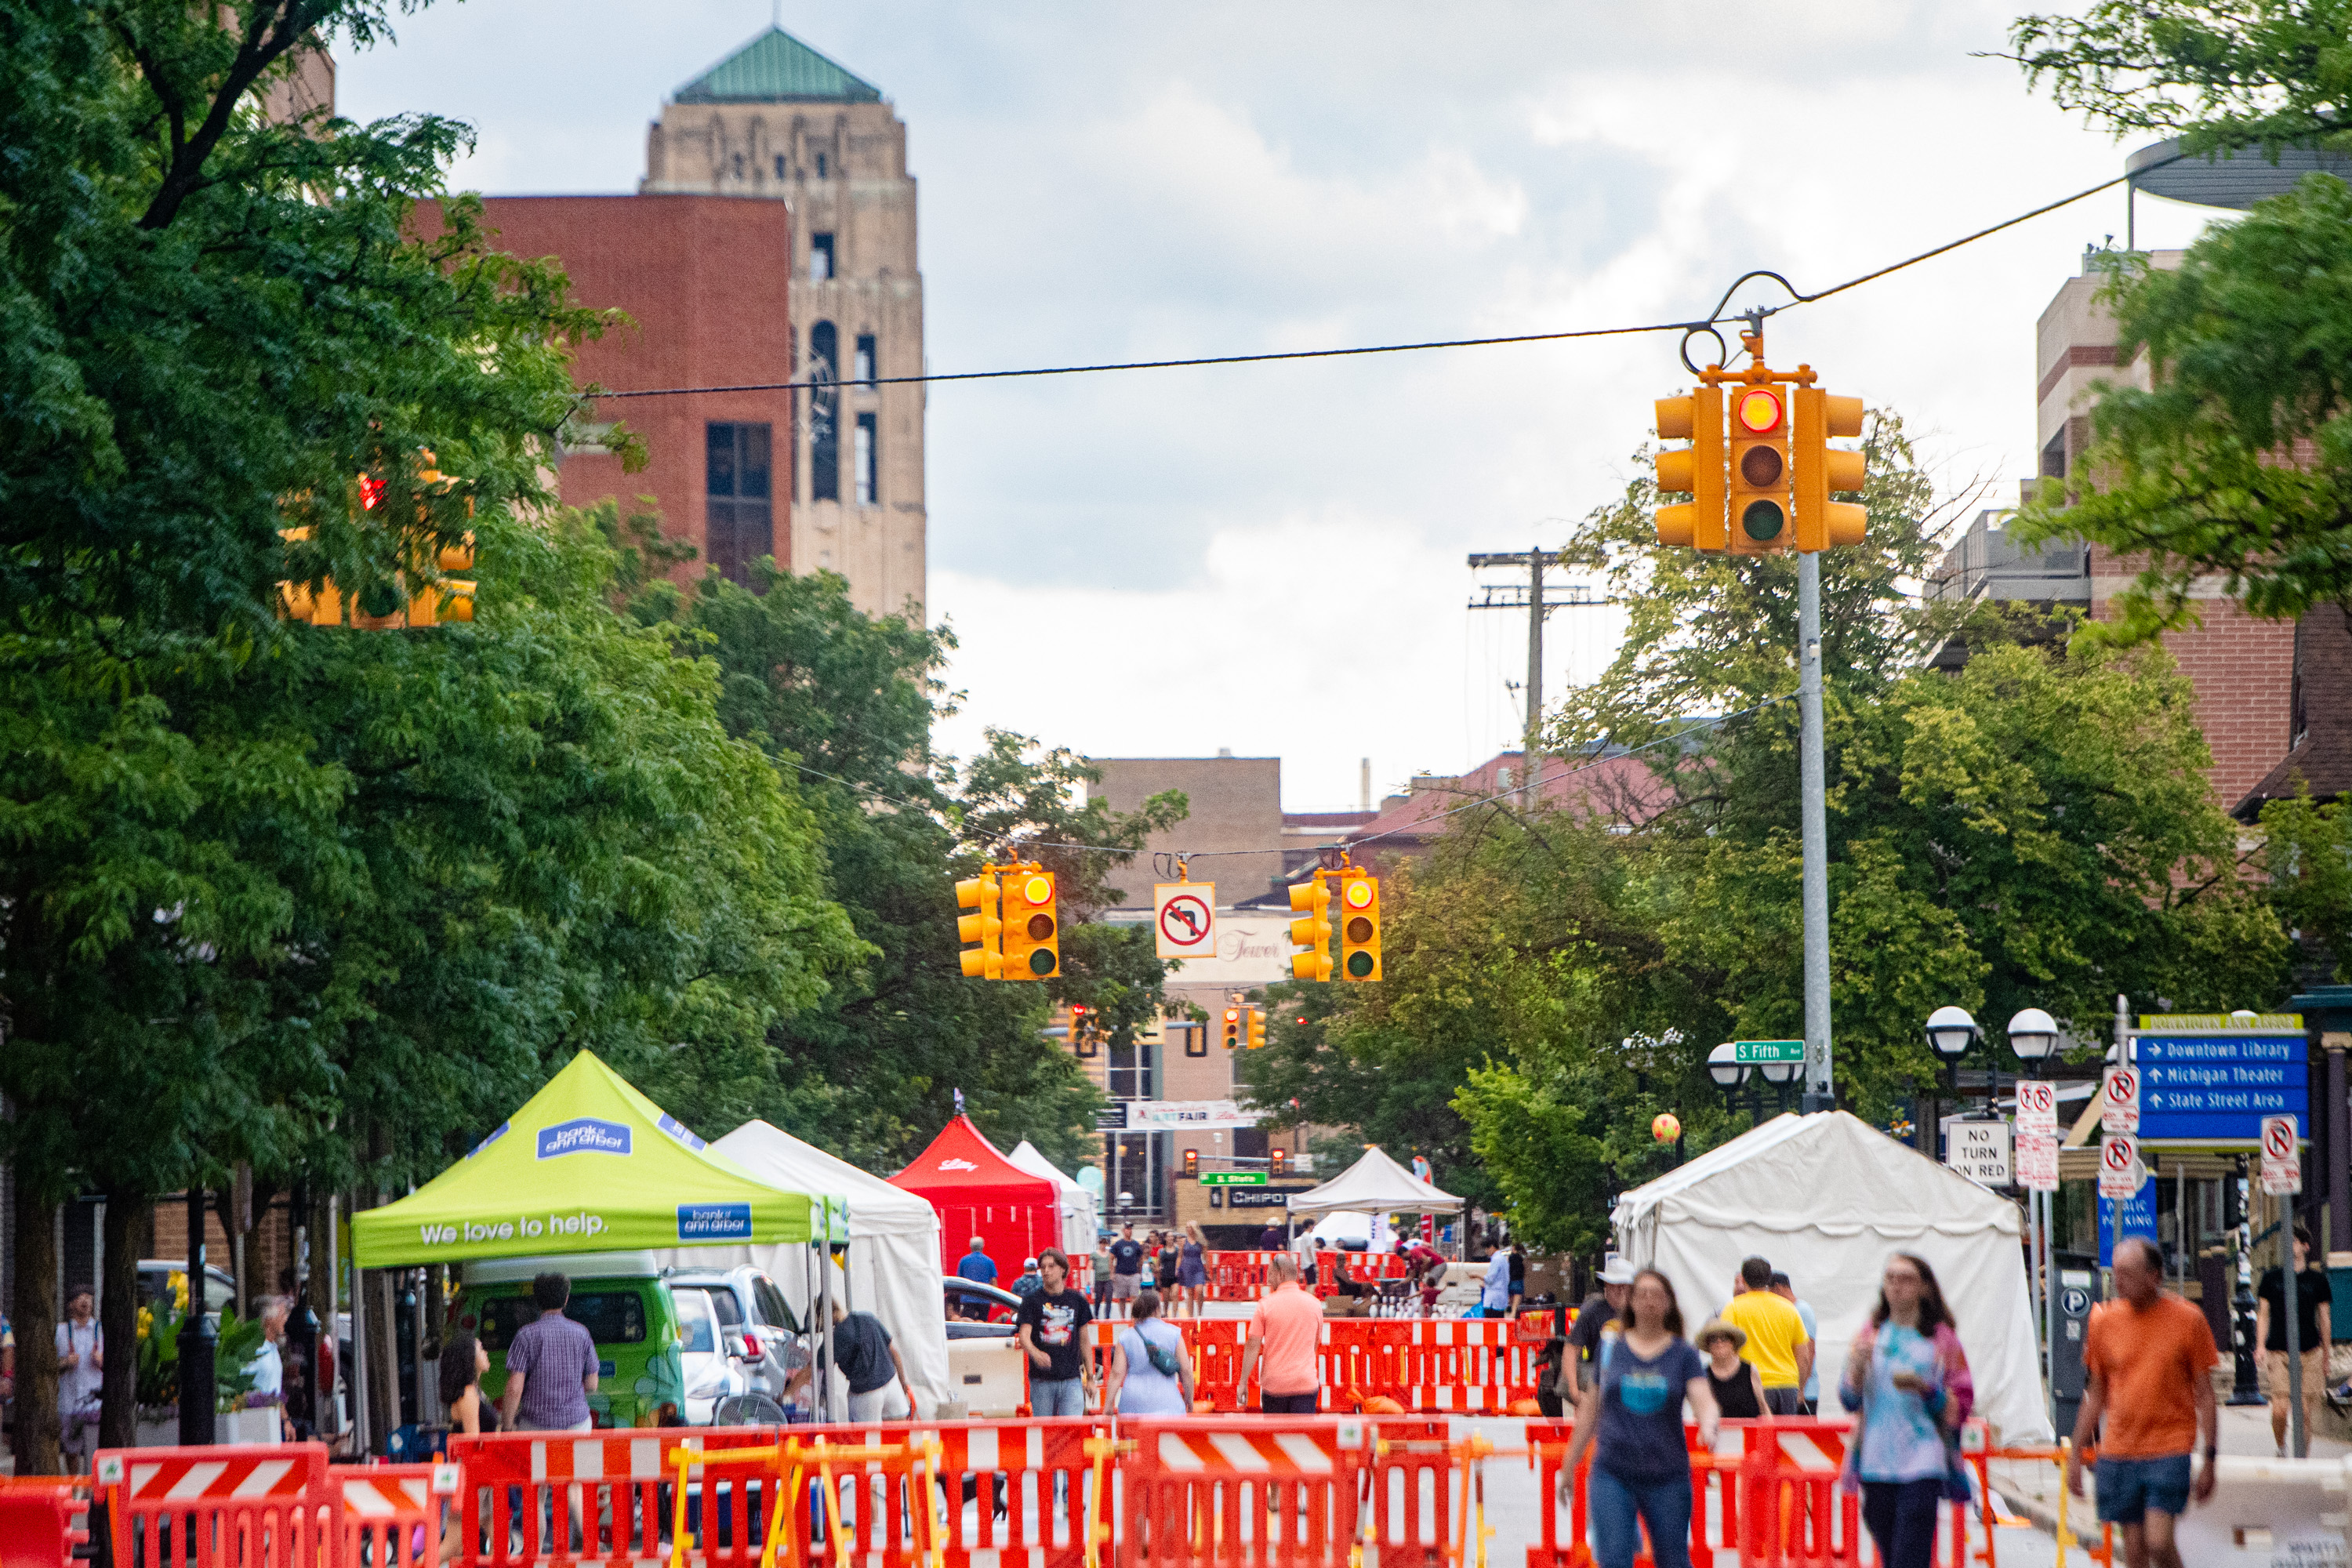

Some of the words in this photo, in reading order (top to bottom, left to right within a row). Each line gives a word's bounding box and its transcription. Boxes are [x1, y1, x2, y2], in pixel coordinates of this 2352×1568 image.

[1753, 1045, 1780, 1058] Fifth
[2168, 1043, 2237, 1058] Downtown
[2243, 1042, 2289, 1060] Library
[2168, 1066, 2228, 1087] Michigan
[2233, 1066, 2283, 1083] Theater
[2169, 1093, 2202, 1109] State
[2208, 1092, 2248, 1109] Street
[2253, 1092, 2284, 1109] Area
[1178, 1112, 1207, 1121] FAIR
[557, 1125, 597, 1139] bank
[1969, 1130, 1989, 1142] NO
[546, 1135, 577, 1152] ann
[579, 1133, 622, 1148] arbor
[1962, 1147, 1997, 1159] TURN
[1980, 1164, 2005, 1176] RED
[2107, 1199, 2146, 1212] PBLIC
[693, 1210, 724, 1221] bank
[421, 1223, 457, 1245] We
[464, 1221, 514, 1242] love
[520, 1216, 543, 1237] to
[684, 1220, 709, 1232] ann
[711, 1219, 745, 1232] arbor
